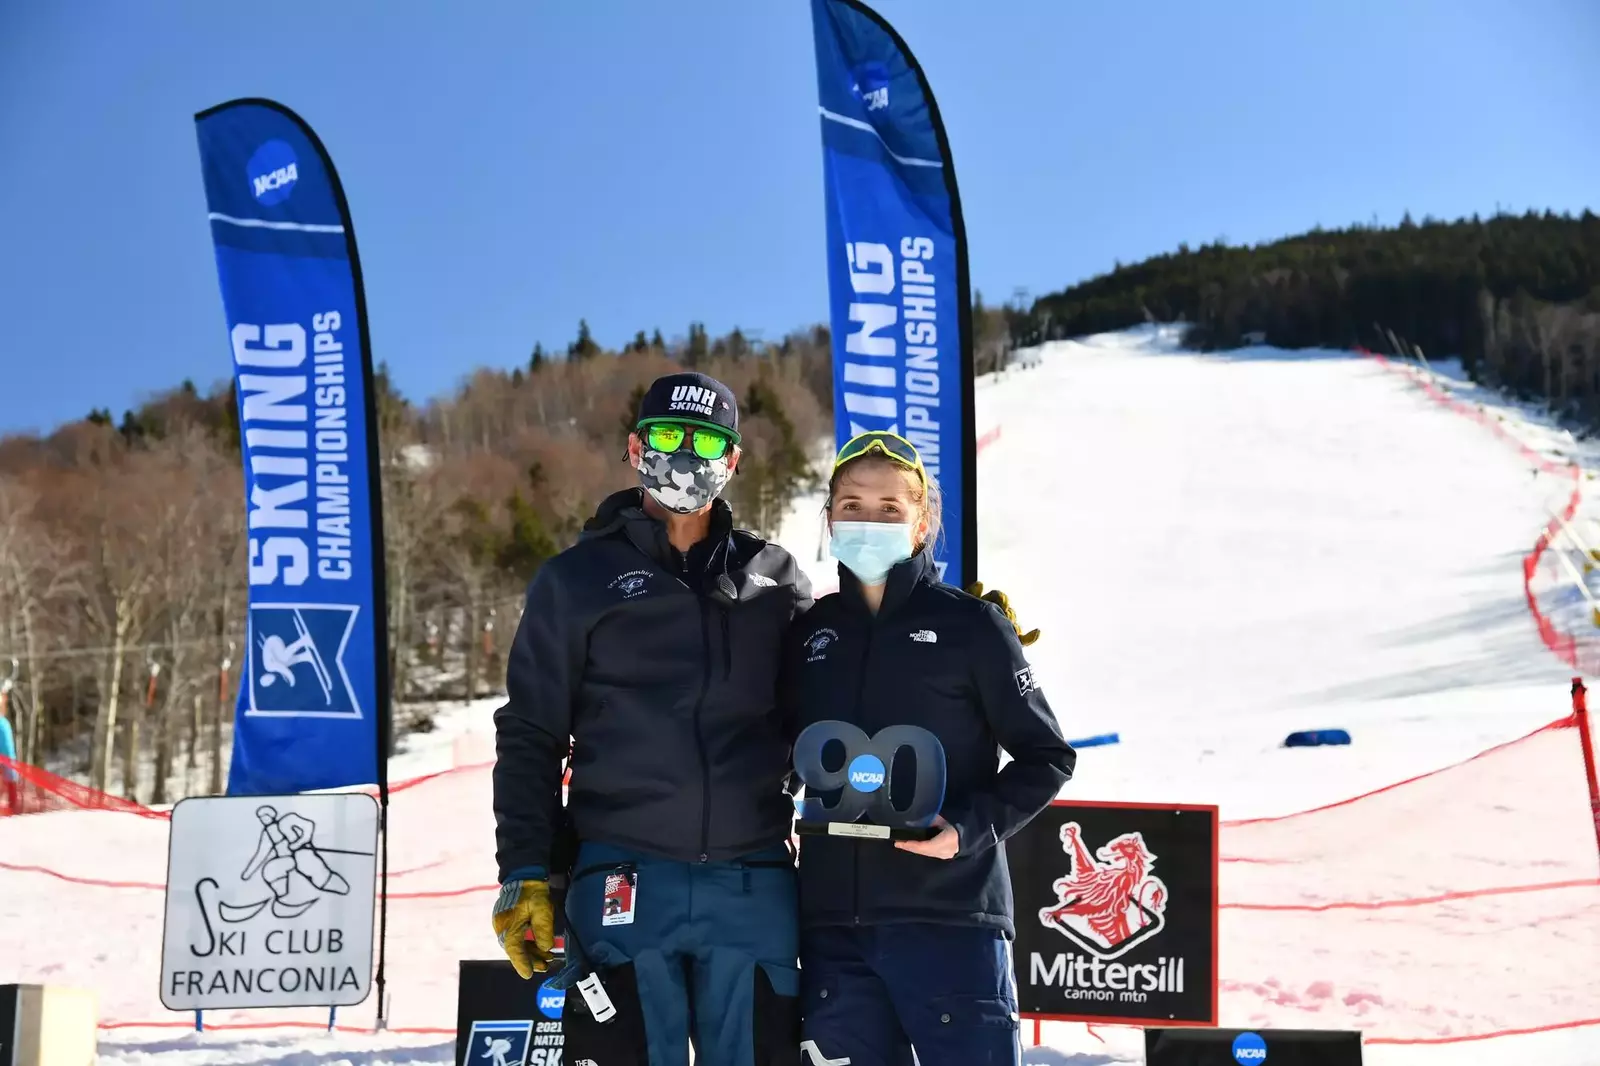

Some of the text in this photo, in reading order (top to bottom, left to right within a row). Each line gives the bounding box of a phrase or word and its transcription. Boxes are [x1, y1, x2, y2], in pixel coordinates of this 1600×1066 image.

[852, 83, 889, 111] CAA
[253, 162, 298, 197] NCAA
[843, 240, 898, 437] IING
[900, 236, 941, 480] MPIONSHIPS
[668, 401, 713, 416] SKIING
[671, 385, 717, 408] UNH
[231, 322, 310, 586] SKIING
[312, 310, 353, 581] CHAMPIONSHIPS
[793, 720, 947, 826] 90
[851, 771, 884, 785] NCAA
[190, 877, 344, 957] SKI CLUB
[170, 966, 361, 996] FRANCONIA
[1030, 951, 1184, 993] Mittersill
[540, 996, 566, 1009] NCA
[1064, 988, 1148, 1003] cannon mtn
[533, 1034, 566, 1046] NATIO
[535, 1021, 563, 1033] 2021
[1235, 1048, 1267, 1059] NCAA
